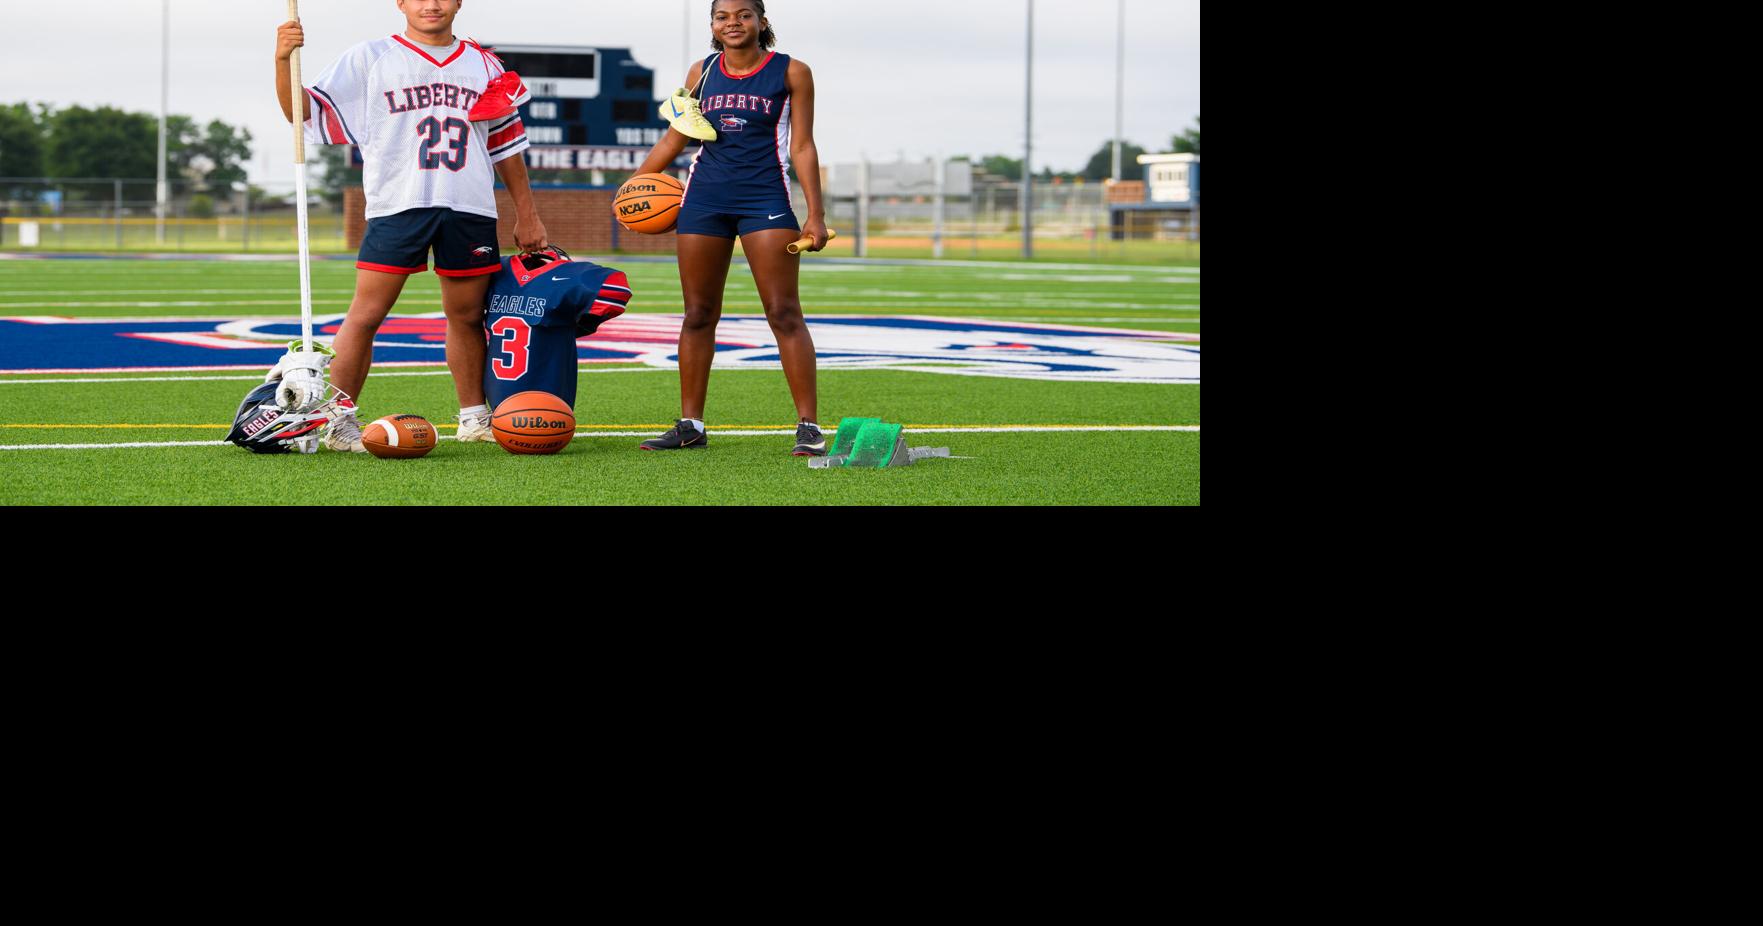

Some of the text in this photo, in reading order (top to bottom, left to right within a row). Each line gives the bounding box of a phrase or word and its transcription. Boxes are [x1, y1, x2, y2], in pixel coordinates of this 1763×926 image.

[384, 82, 481, 114] LIBERT
[701, 93, 773, 115] LIBERTY
[416, 115, 470, 172] 23
[528, 149, 651, 170] THE EAGLE
[619, 201, 651, 216] NCAA
[489, 294, 547, 318] EAGLES
[491, 315, 532, 381] 3
[242, 409, 279, 437] EAGLES
[511, 416, 566, 429] Wilson
